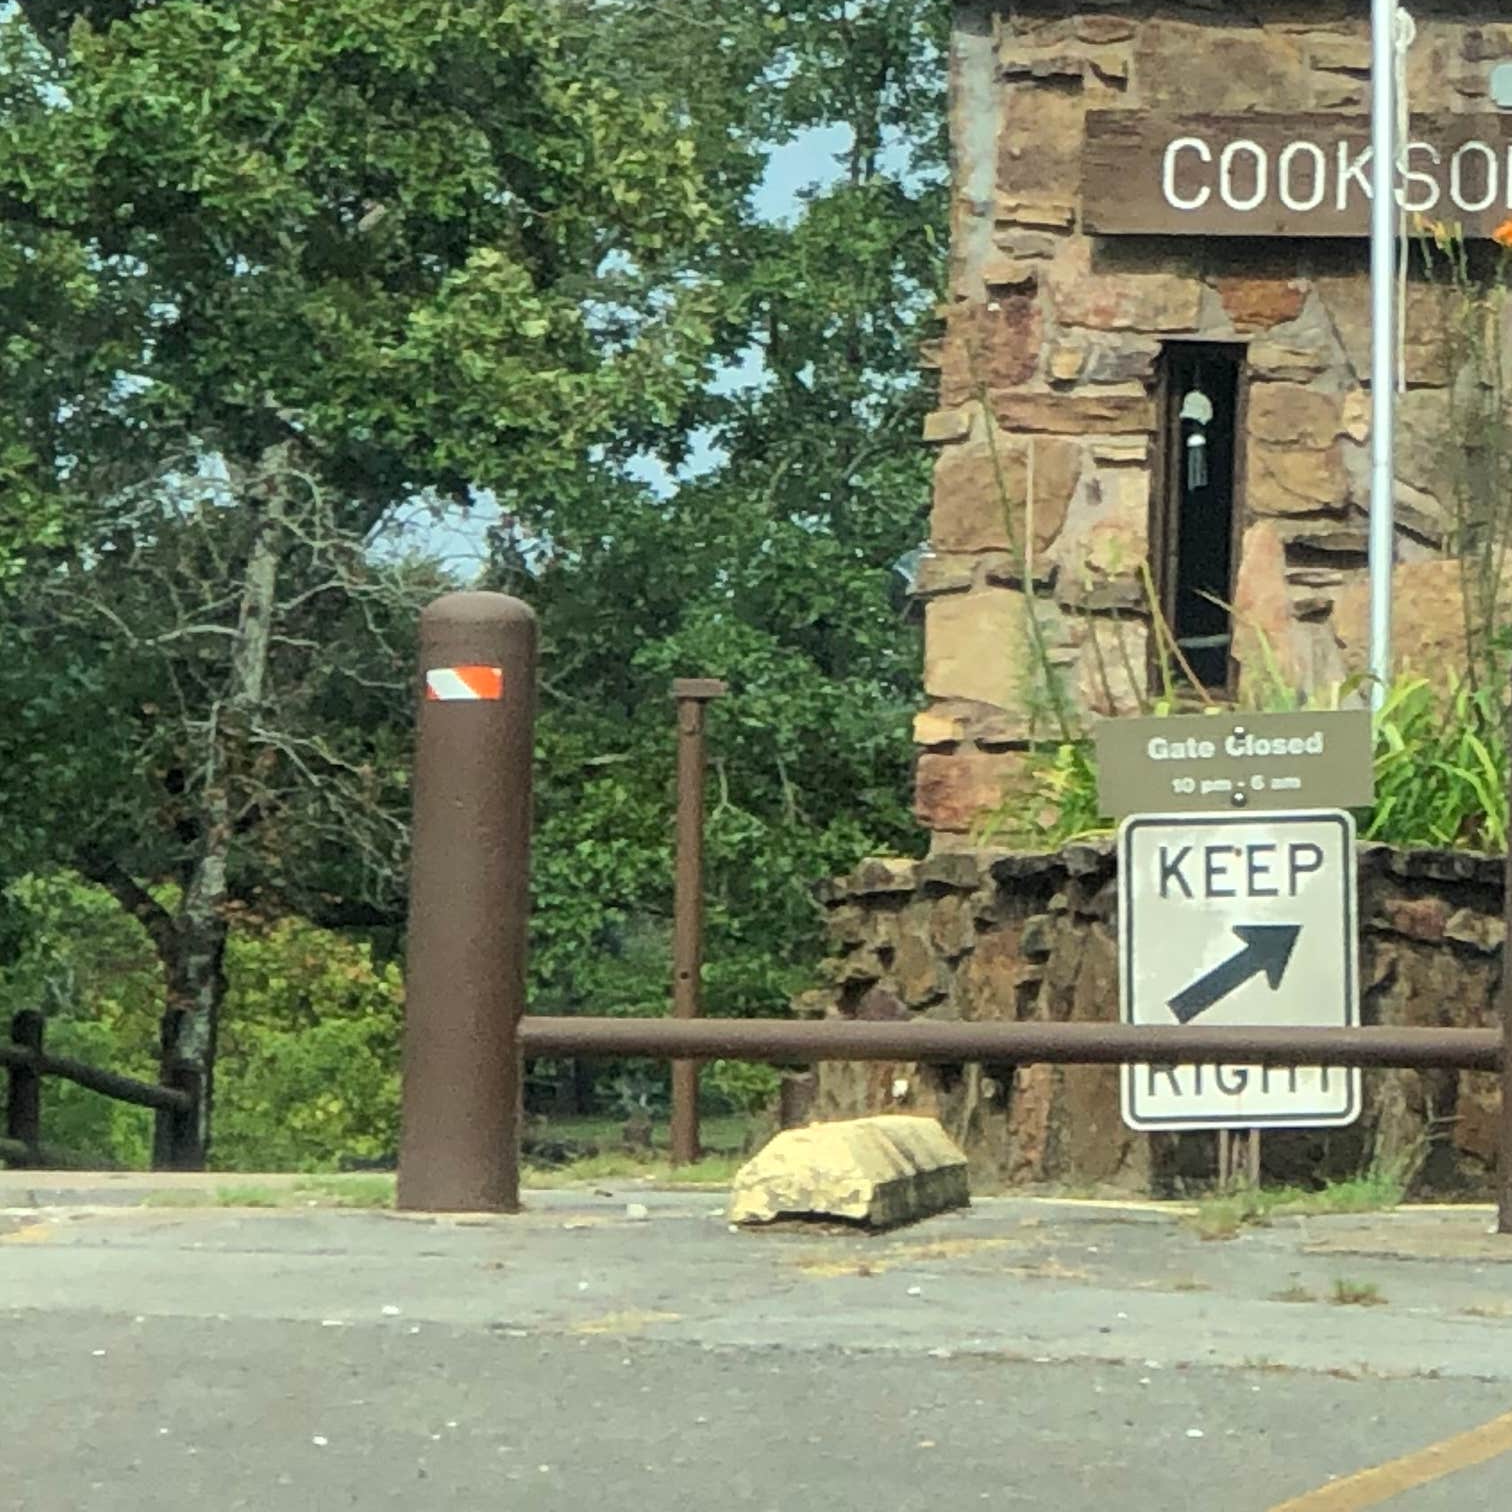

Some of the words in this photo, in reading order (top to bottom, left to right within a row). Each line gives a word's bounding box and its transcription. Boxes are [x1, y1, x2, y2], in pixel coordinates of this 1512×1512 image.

[1147, 737, 1216, 760] Gate
[1224, 730, 1324, 756] Closed
[1171, 776, 1196, 794] 10
[1200, 778, 1232, 795] pm
[1250, 774, 1265, 790] 6
[1270, 776, 1301, 790] am
[1158, 842, 1324, 899] KEEP
